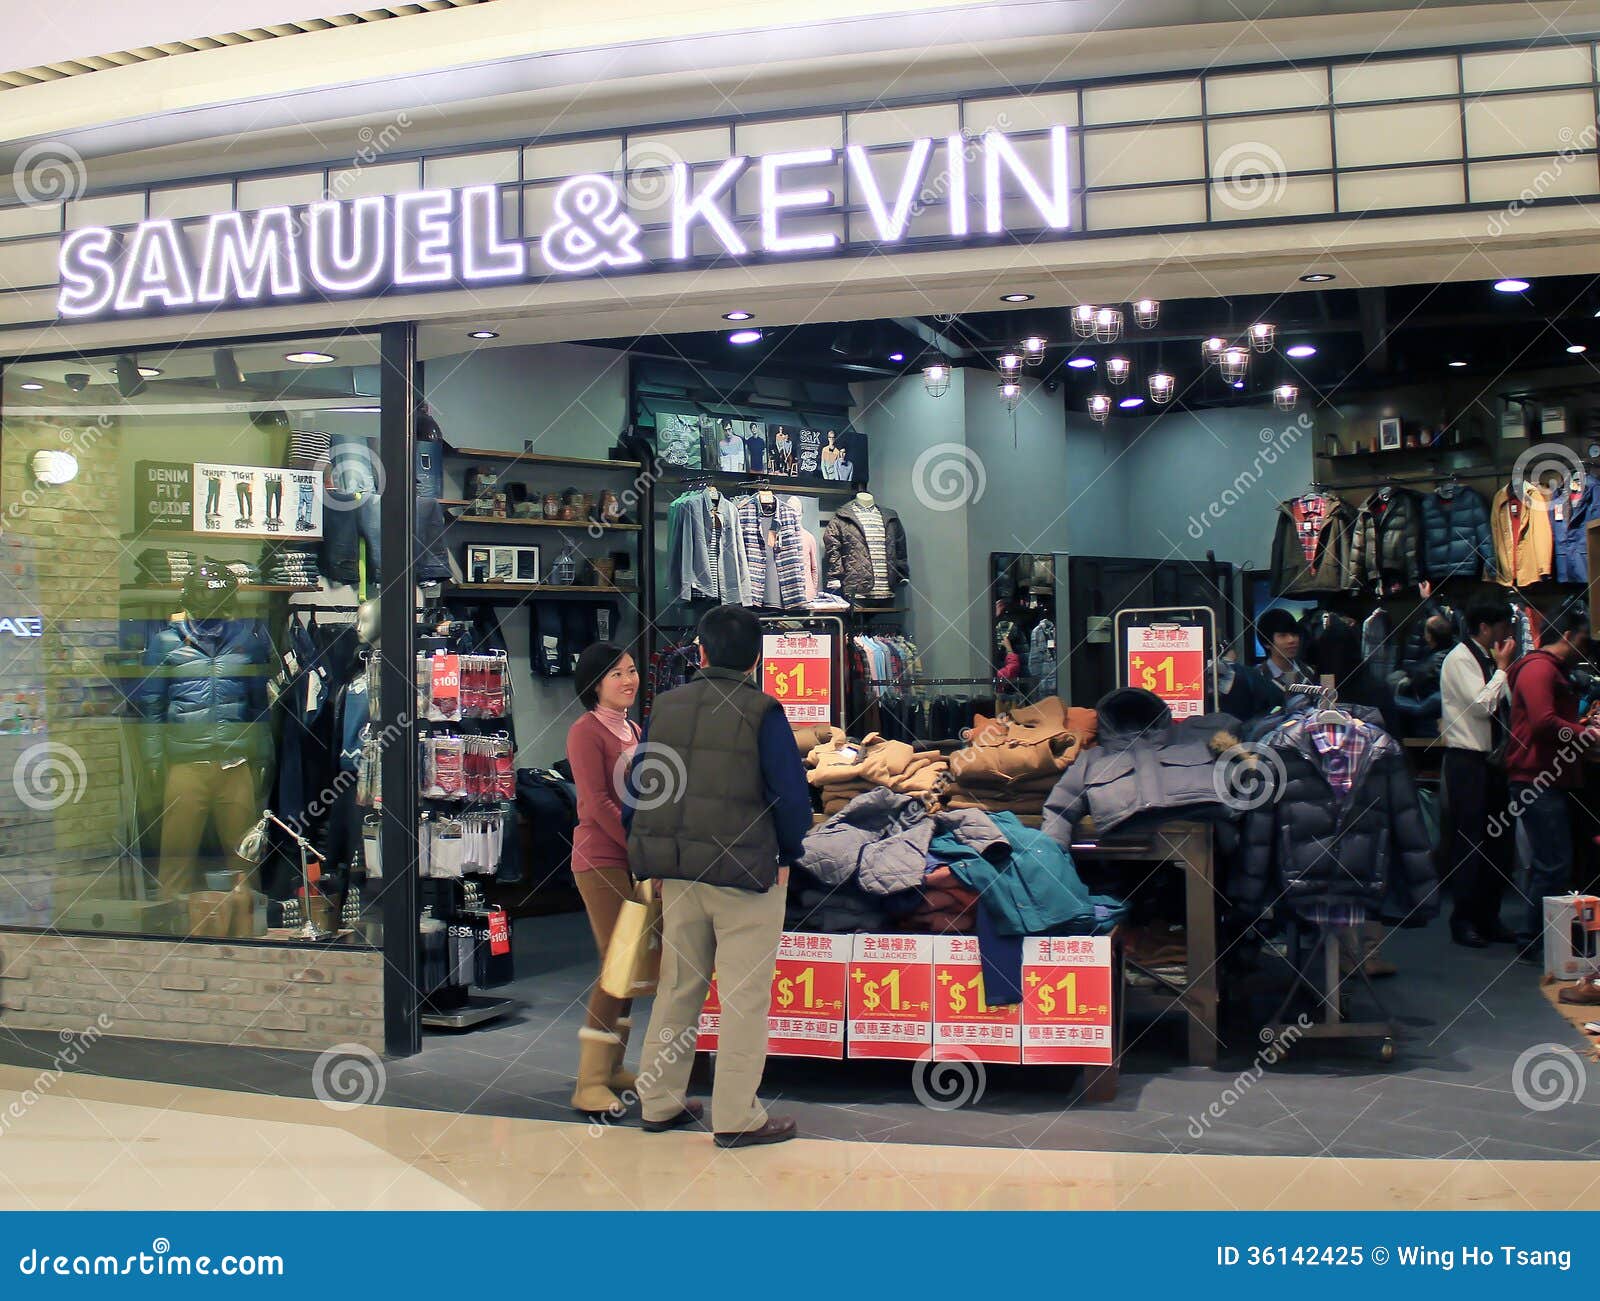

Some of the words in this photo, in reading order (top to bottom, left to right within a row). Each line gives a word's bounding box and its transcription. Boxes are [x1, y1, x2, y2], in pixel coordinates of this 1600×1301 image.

[58, 185, 524, 316] SAMUEL
[541, 173, 643, 272] &
[671, 125, 1070, 260] KEVIN
[148, 469, 188, 483] DENIM
[157, 484, 181, 498] FIT
[149, 502, 190, 515] GUIDE
[208, 580, 227, 589] S&K
[433, 676, 458, 687] $100
[784, 706, 825, 717] 至本週日
[491, 931, 508, 943] $100
[950, 939, 977, 953] 全場
[779, 949, 794, 957] ALL
[797, 950, 833, 958] JACKETS
[880, 952, 917, 960] JACKETS
[1056, 955, 1096, 963] JACKETS
